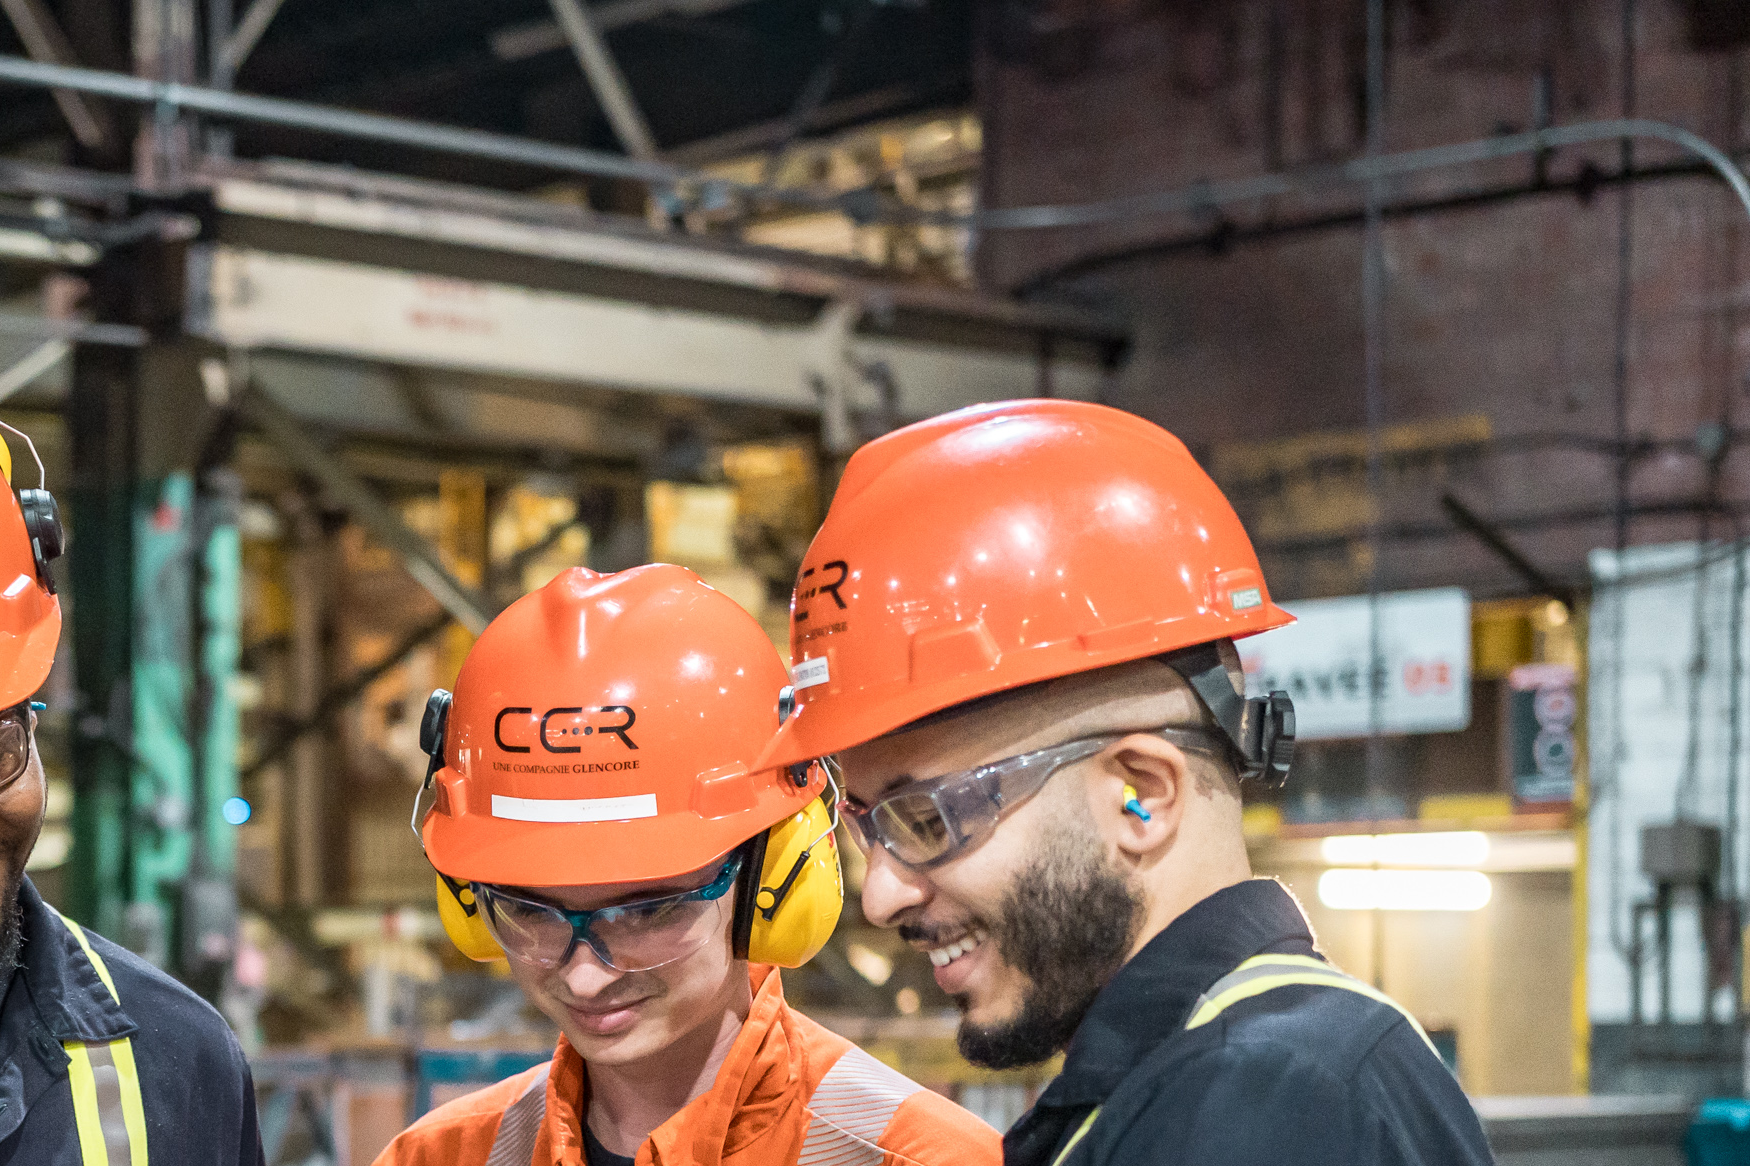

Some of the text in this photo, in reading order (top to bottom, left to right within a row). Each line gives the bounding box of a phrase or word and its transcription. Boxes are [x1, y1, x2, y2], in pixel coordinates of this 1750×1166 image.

[493, 760, 640, 774] UNE COMPAGNIE GLENCORE
